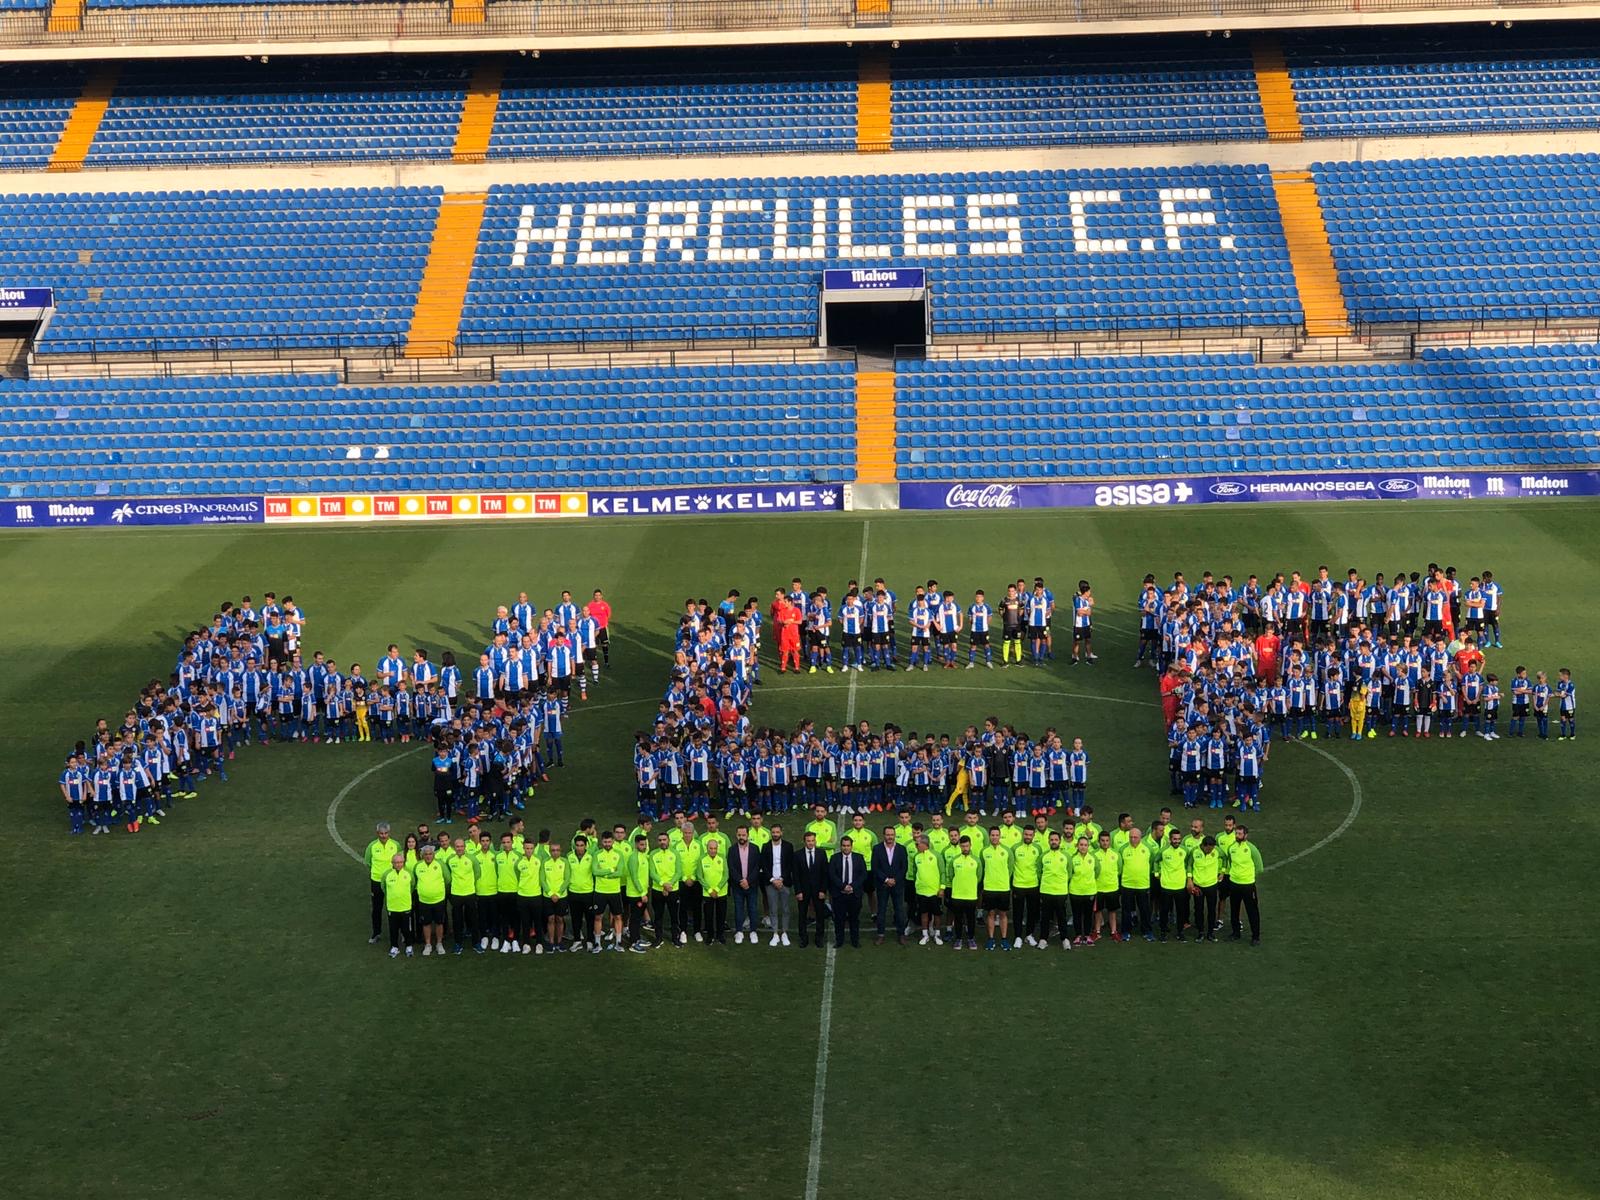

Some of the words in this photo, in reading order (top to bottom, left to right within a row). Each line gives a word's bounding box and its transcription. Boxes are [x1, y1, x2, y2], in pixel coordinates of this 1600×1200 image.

[511, 192, 1023, 267] HERCULES
[851, 270, 897, 282] Mahou
[1423, 476, 1470, 488] Mahou
[1521, 476, 1568, 489] Mahou
[945, 484, 1017, 508] Coca-Cola
[1095, 483, 1170, 506] asisa
[184, 501, 258, 513] PANORAMIS
[268, 503, 287, 513] TM
[323, 502, 341, 513] TM
[376, 501, 394, 512] TM
[430, 500, 447, 511] TM
[483, 499, 502, 511] TM
[537, 498, 556, 510] TM
[592, 495, 690, 513] KELME
[716, 491, 815, 510] KELME
[49, 504, 94, 516] Mahou
